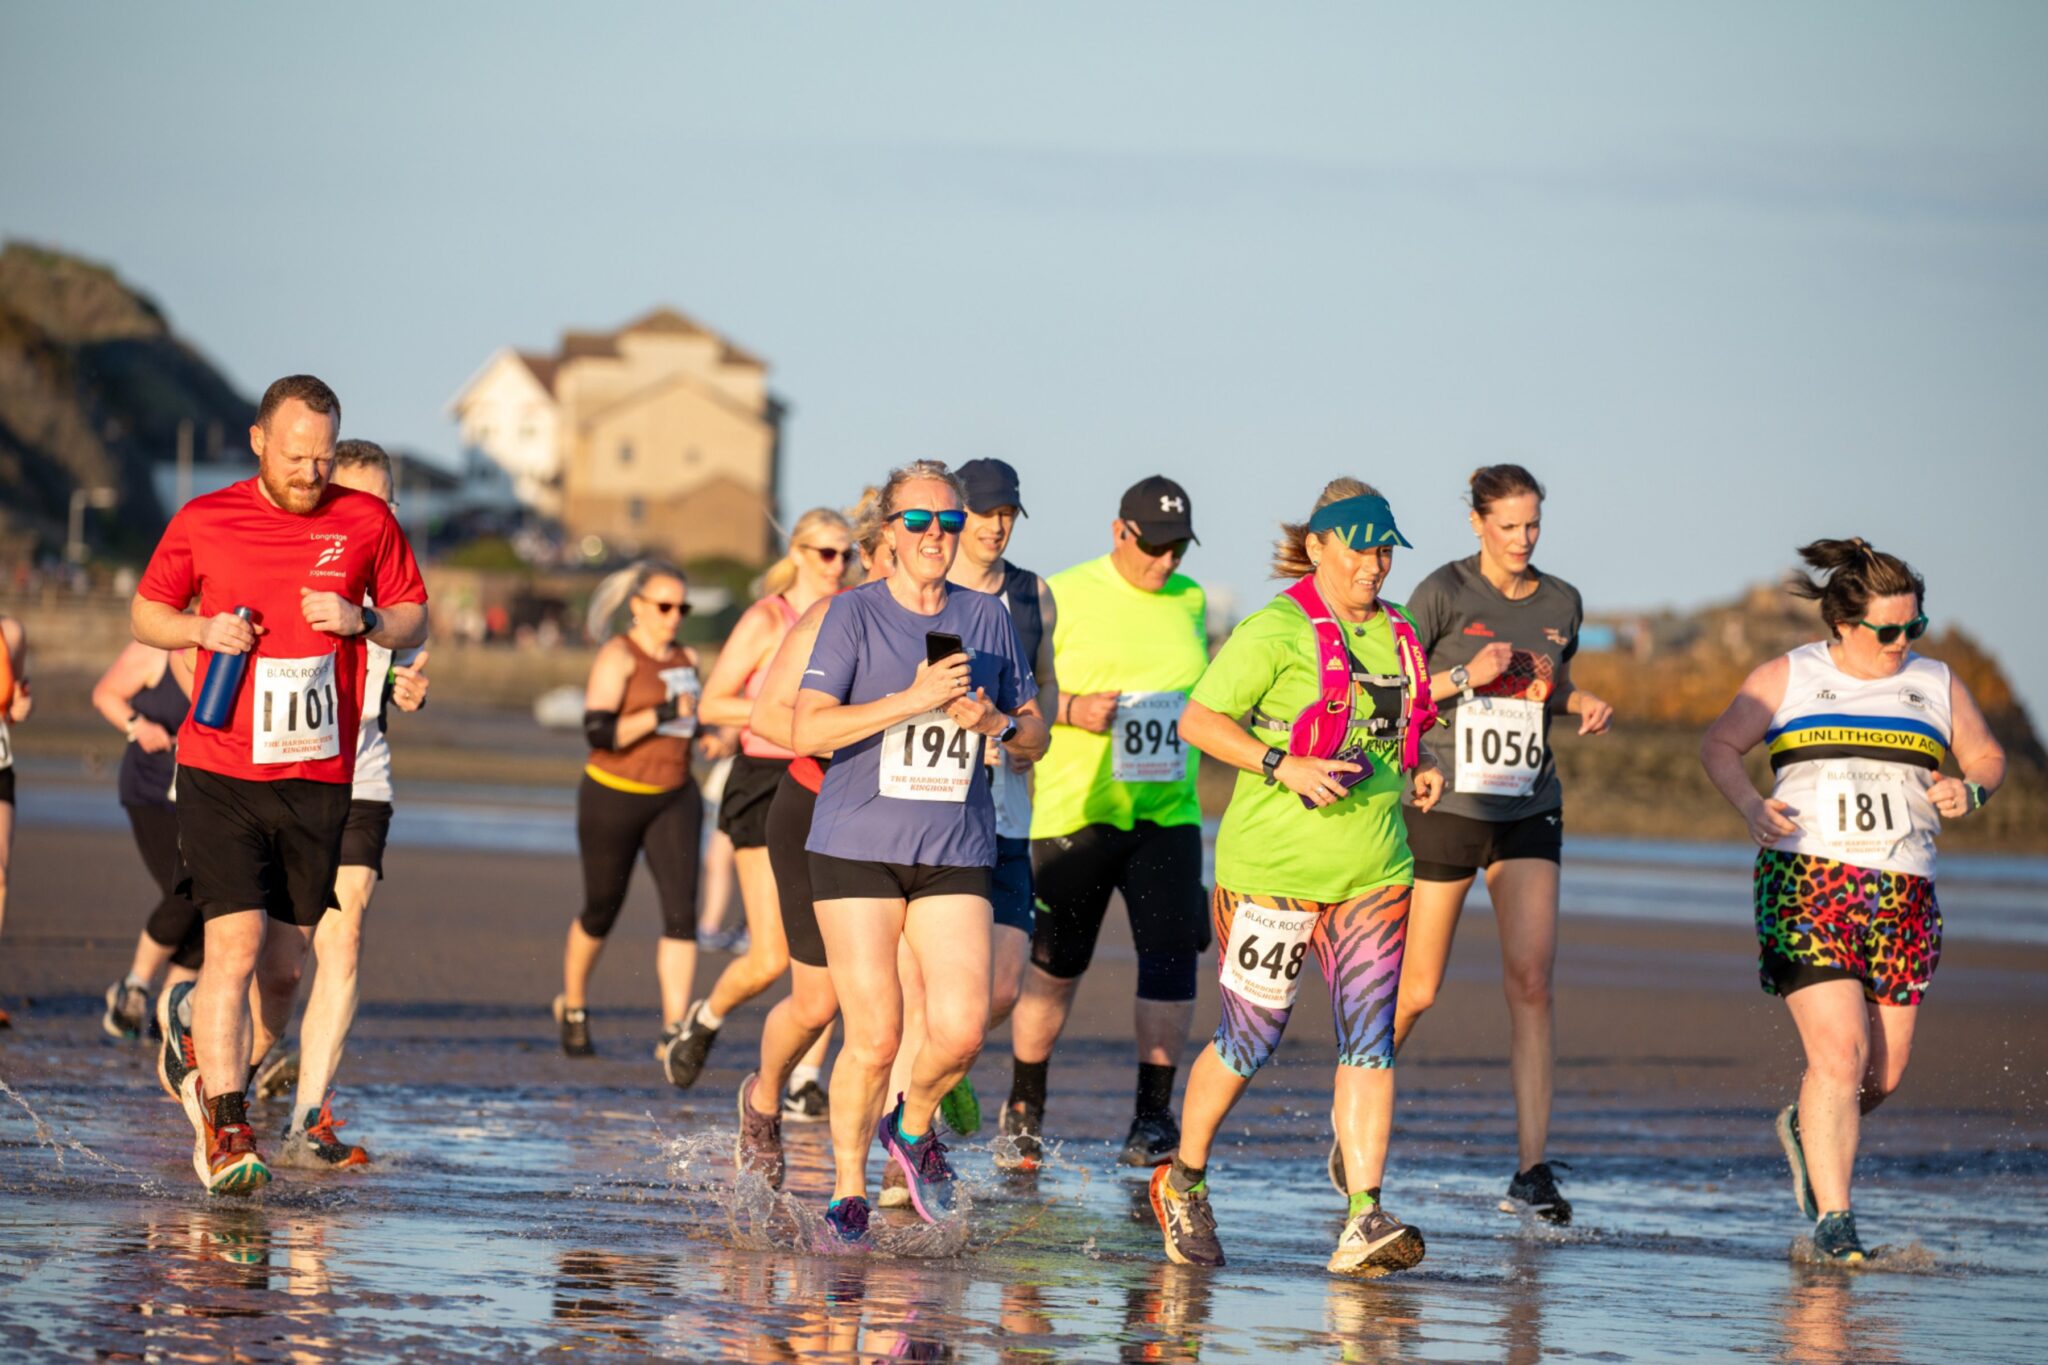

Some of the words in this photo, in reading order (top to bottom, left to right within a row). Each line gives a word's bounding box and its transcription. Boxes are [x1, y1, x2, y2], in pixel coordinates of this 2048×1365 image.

[310, 533, 348, 541] Longridge
[267, 668, 299, 678] BLACK
[263, 684, 334, 732] 1101
[904, 725, 970, 769] 194
[1124, 719, 1182, 755] 894
[1466, 728, 1542, 769] 1056
[1799, 730, 1915, 746] LINLITHGOW
[1918, 738, 1935, 752] AC
[1838, 792, 1894, 832] 181
[1245, 911, 1276, 929] BLACK
[1279, 921, 1305, 932] ROCK
[1238, 934, 1308, 980] 648
